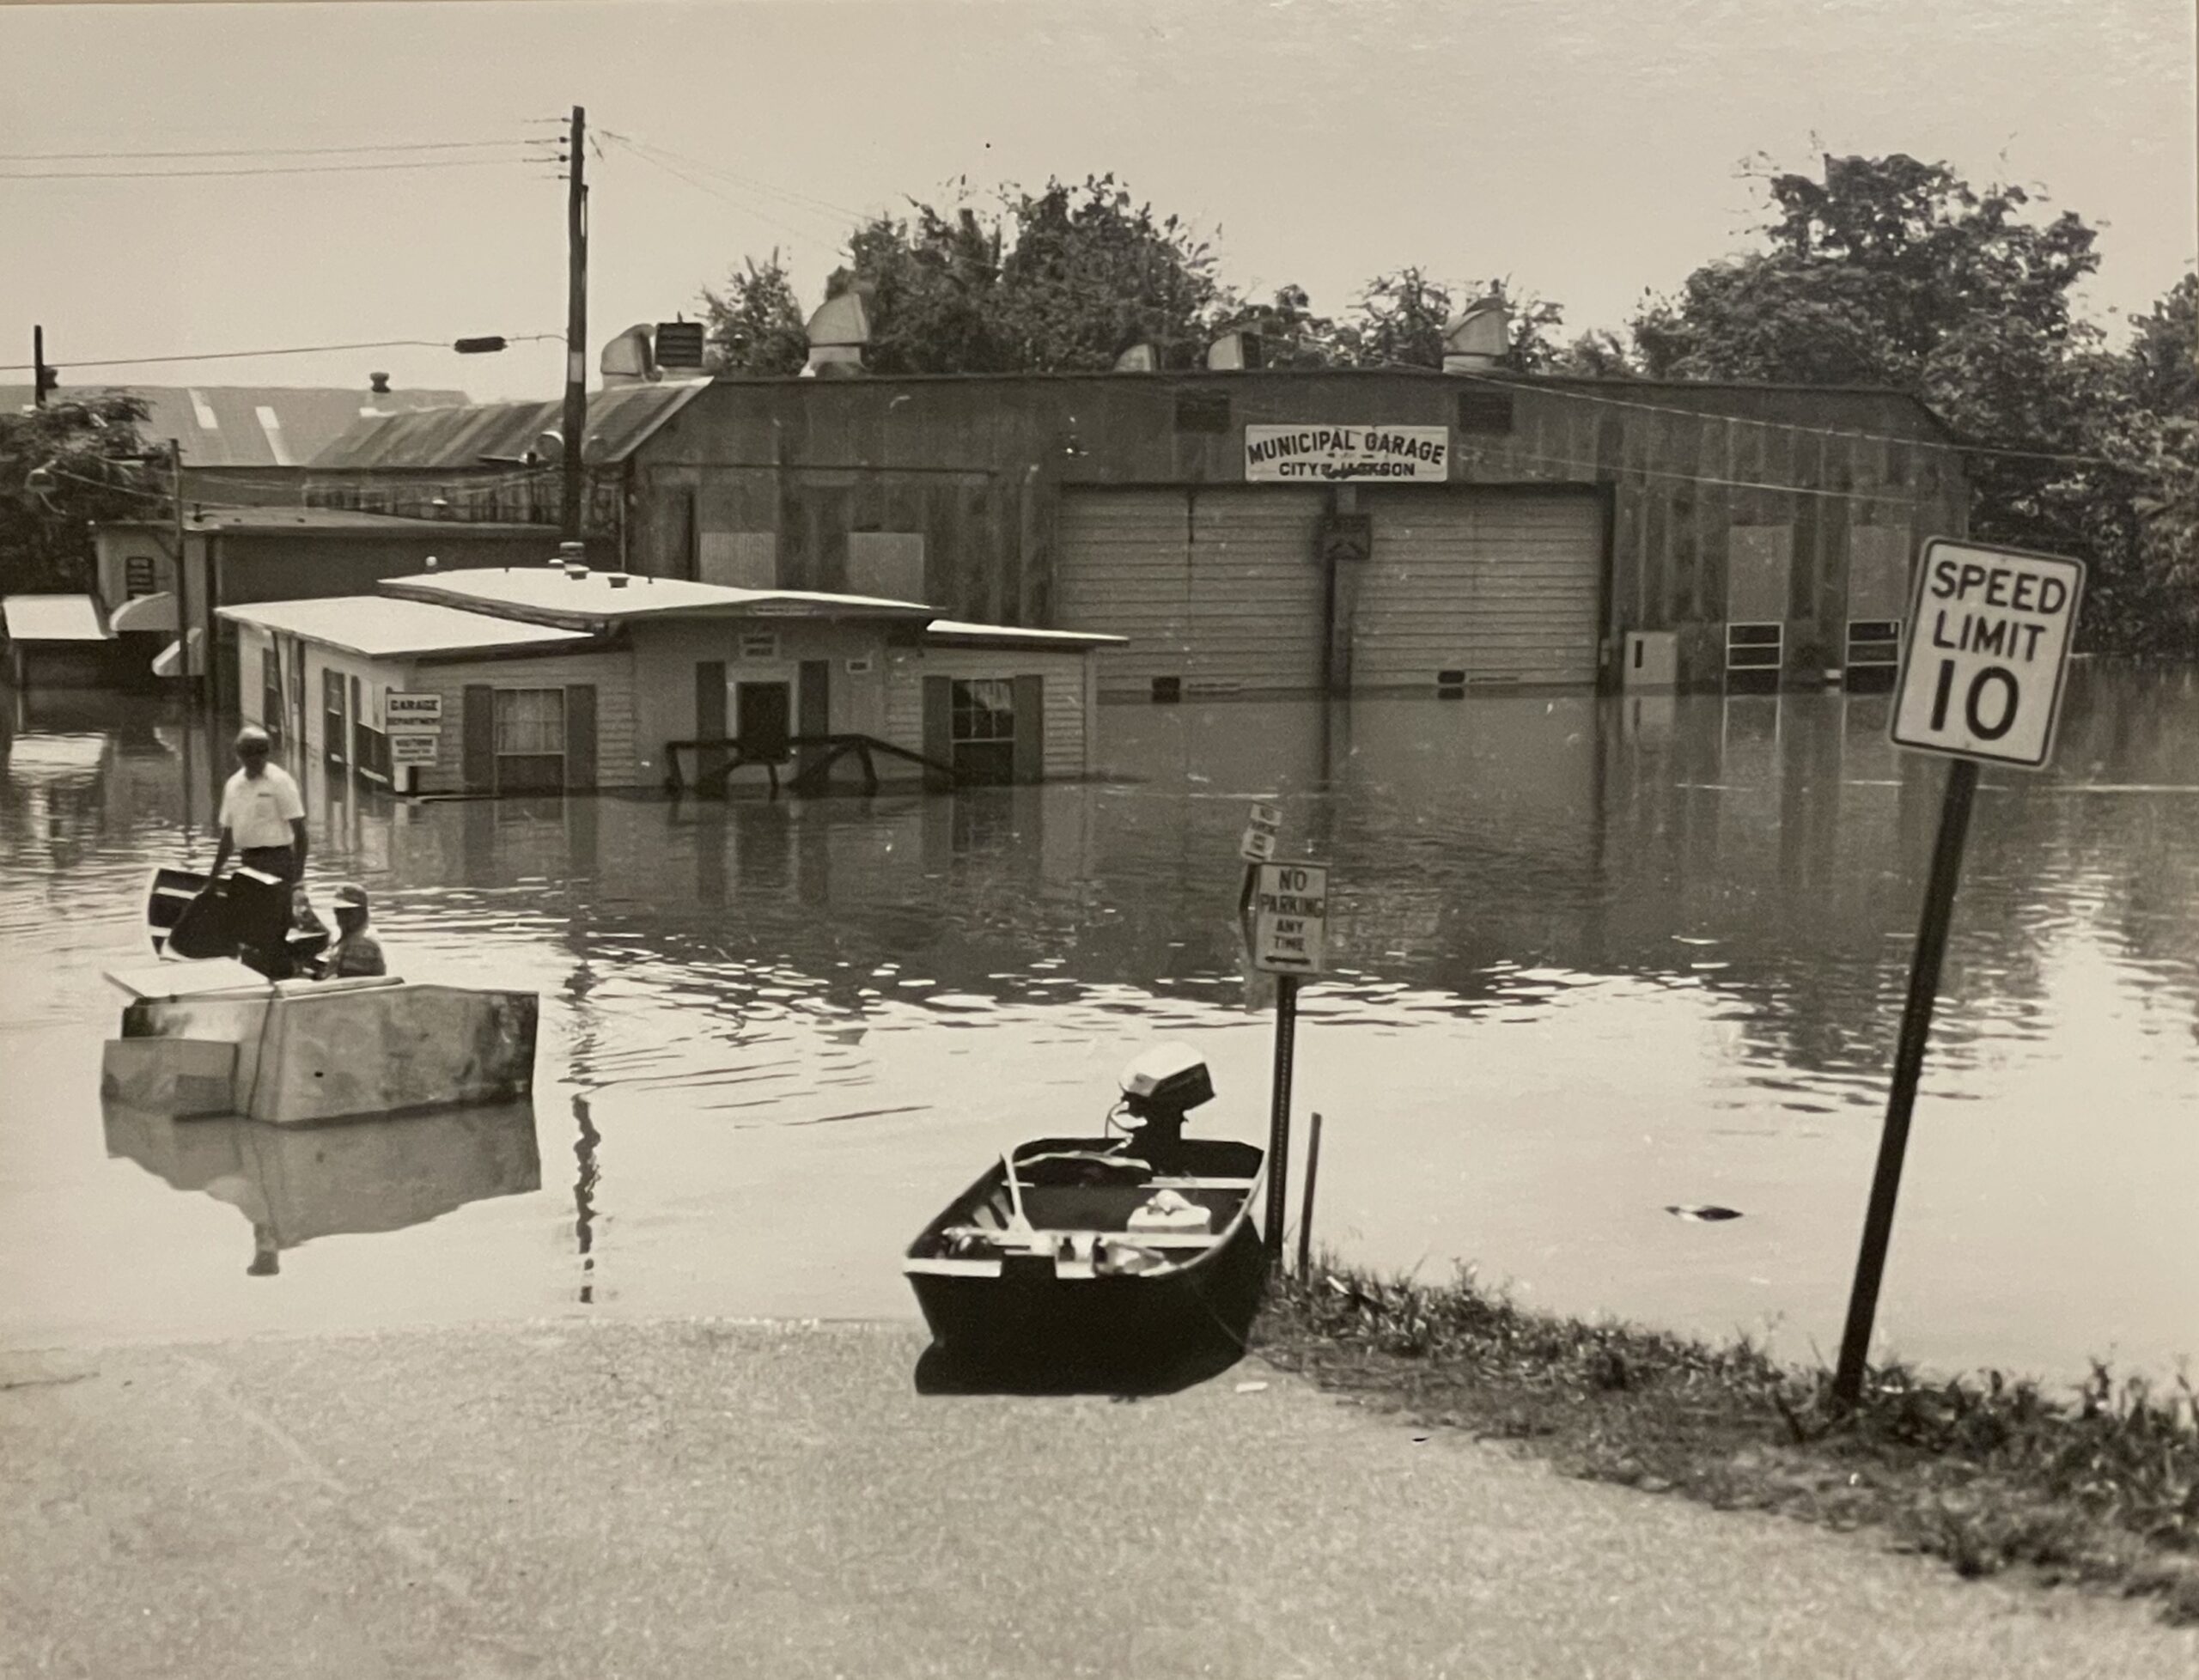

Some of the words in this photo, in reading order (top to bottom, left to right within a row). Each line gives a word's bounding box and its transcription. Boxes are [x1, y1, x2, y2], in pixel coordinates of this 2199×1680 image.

[1248, 430, 1355, 465] MUNICIPAL
[1365, 432, 1445, 465] GARAGE
[1279, 462, 1319, 477] CITY
[1931, 561, 2067, 614] SPEED
[1934, 610, 2047, 662] LIMIT
[1930, 660, 2019, 741] 10
[1279, 869, 1307, 892] NO
[1260, 893, 1325, 918] PARKING
[1276, 919, 1305, 934] ANY
[1274, 936, 1305, 952] TIME
